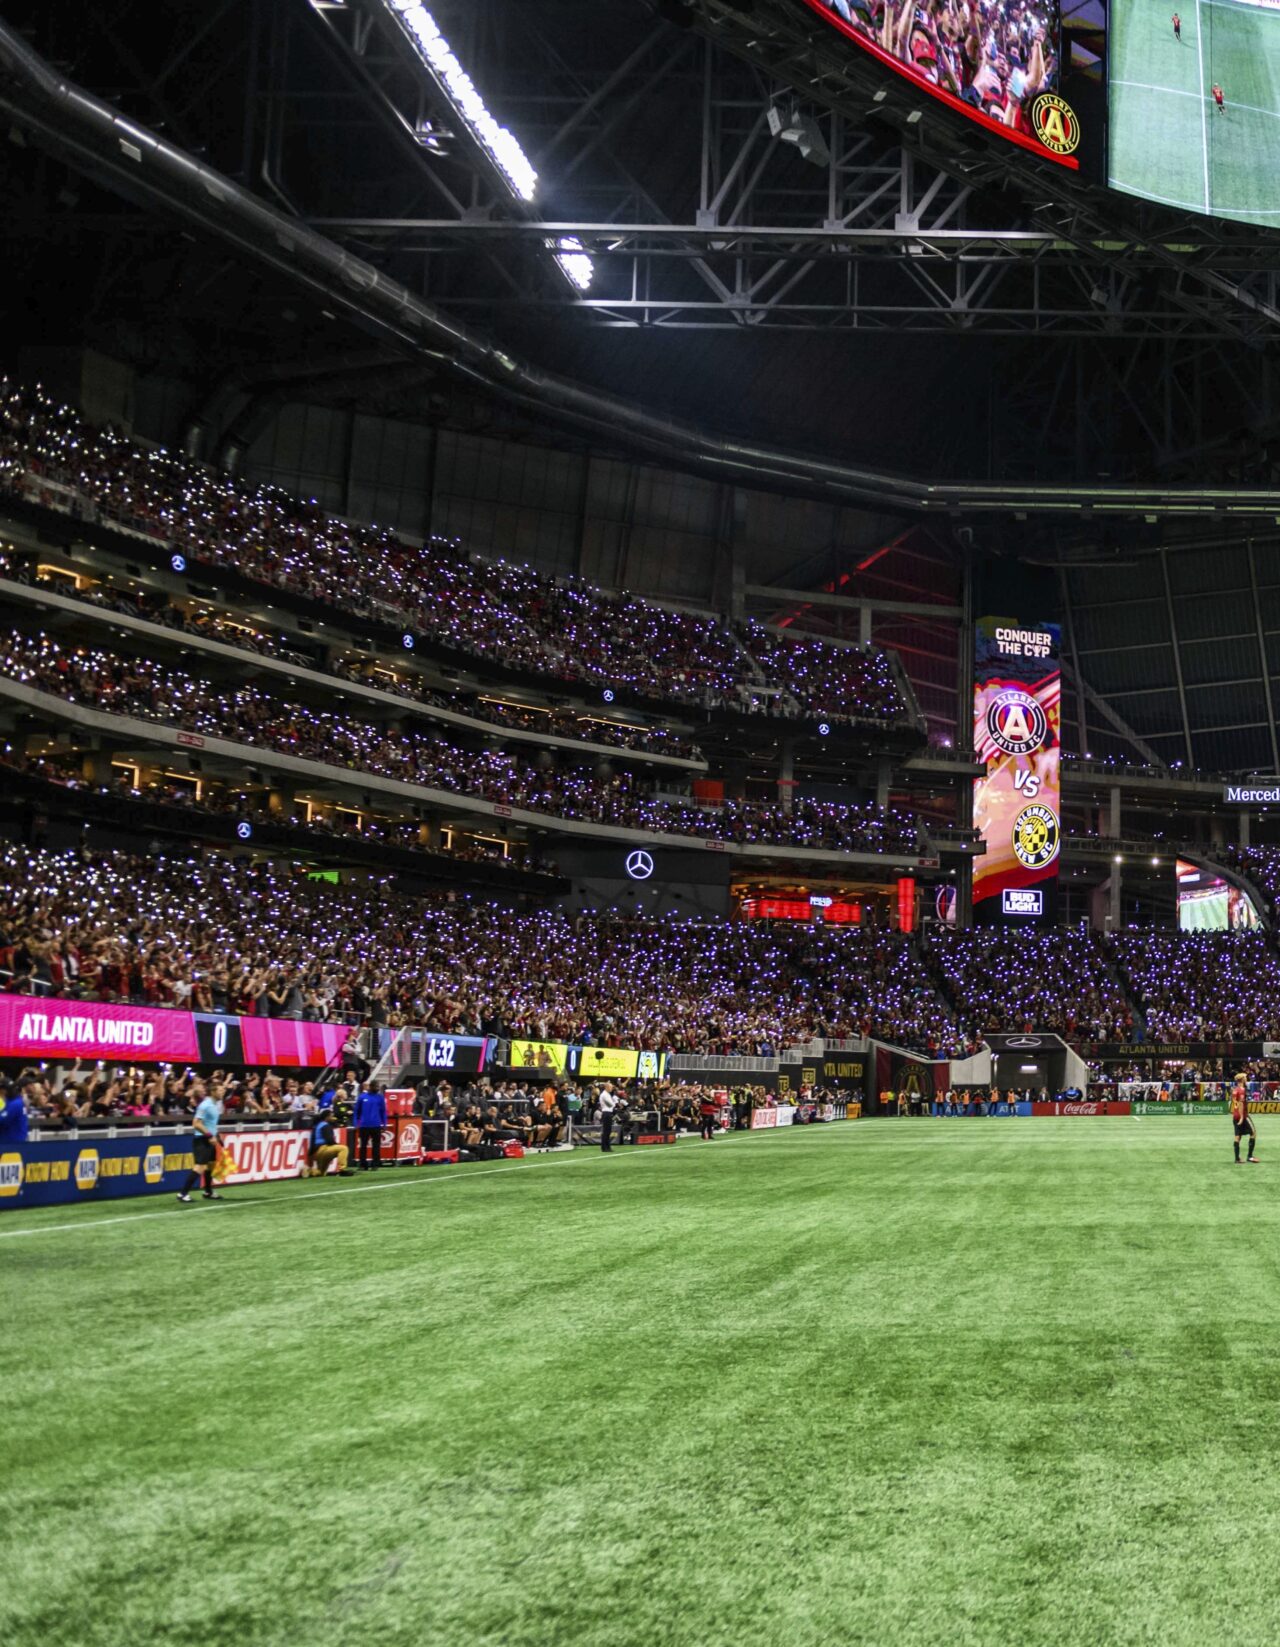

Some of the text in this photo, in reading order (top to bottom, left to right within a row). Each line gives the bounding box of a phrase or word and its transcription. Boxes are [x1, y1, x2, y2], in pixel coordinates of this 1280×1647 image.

[1040, 96, 1073, 118] ATLANTA
[1038, 127, 1064, 152] UNITED
[995, 628, 1052, 646] CONQUER
[997, 640, 1022, 655] THE
[995, 692, 1037, 710] ATLANTA
[992, 731, 1027, 752] UNITED
[1013, 768, 1040, 798] VS
[1015, 807, 1054, 832] COLUMBUS
[1015, 842, 1036, 864] CREW
[1005, 901, 1040, 912] LIGHT
[1010, 891, 1036, 902] BUD
[18, 1013, 154, 1047] ATLANTA UNITED
[213, 1021, 228, 1055] 0
[428, 1038, 455, 1068] 6:32
[569, 1049, 577, 1070] 0
[1119, 1046, 1157, 1054] ATLANTA
[838, 1063, 863, 1078] UNITED
[1063, 1103, 1098, 1115] Coca-Cola
[636, 1135, 665, 1145] ESPN
[0, 1164, 20, 1186] NAPA
[26, 1161, 70, 1183] KNOW HOW
[79, 1159, 96, 1179] NAPA
[101, 1156, 140, 1177] KNOW HOW
